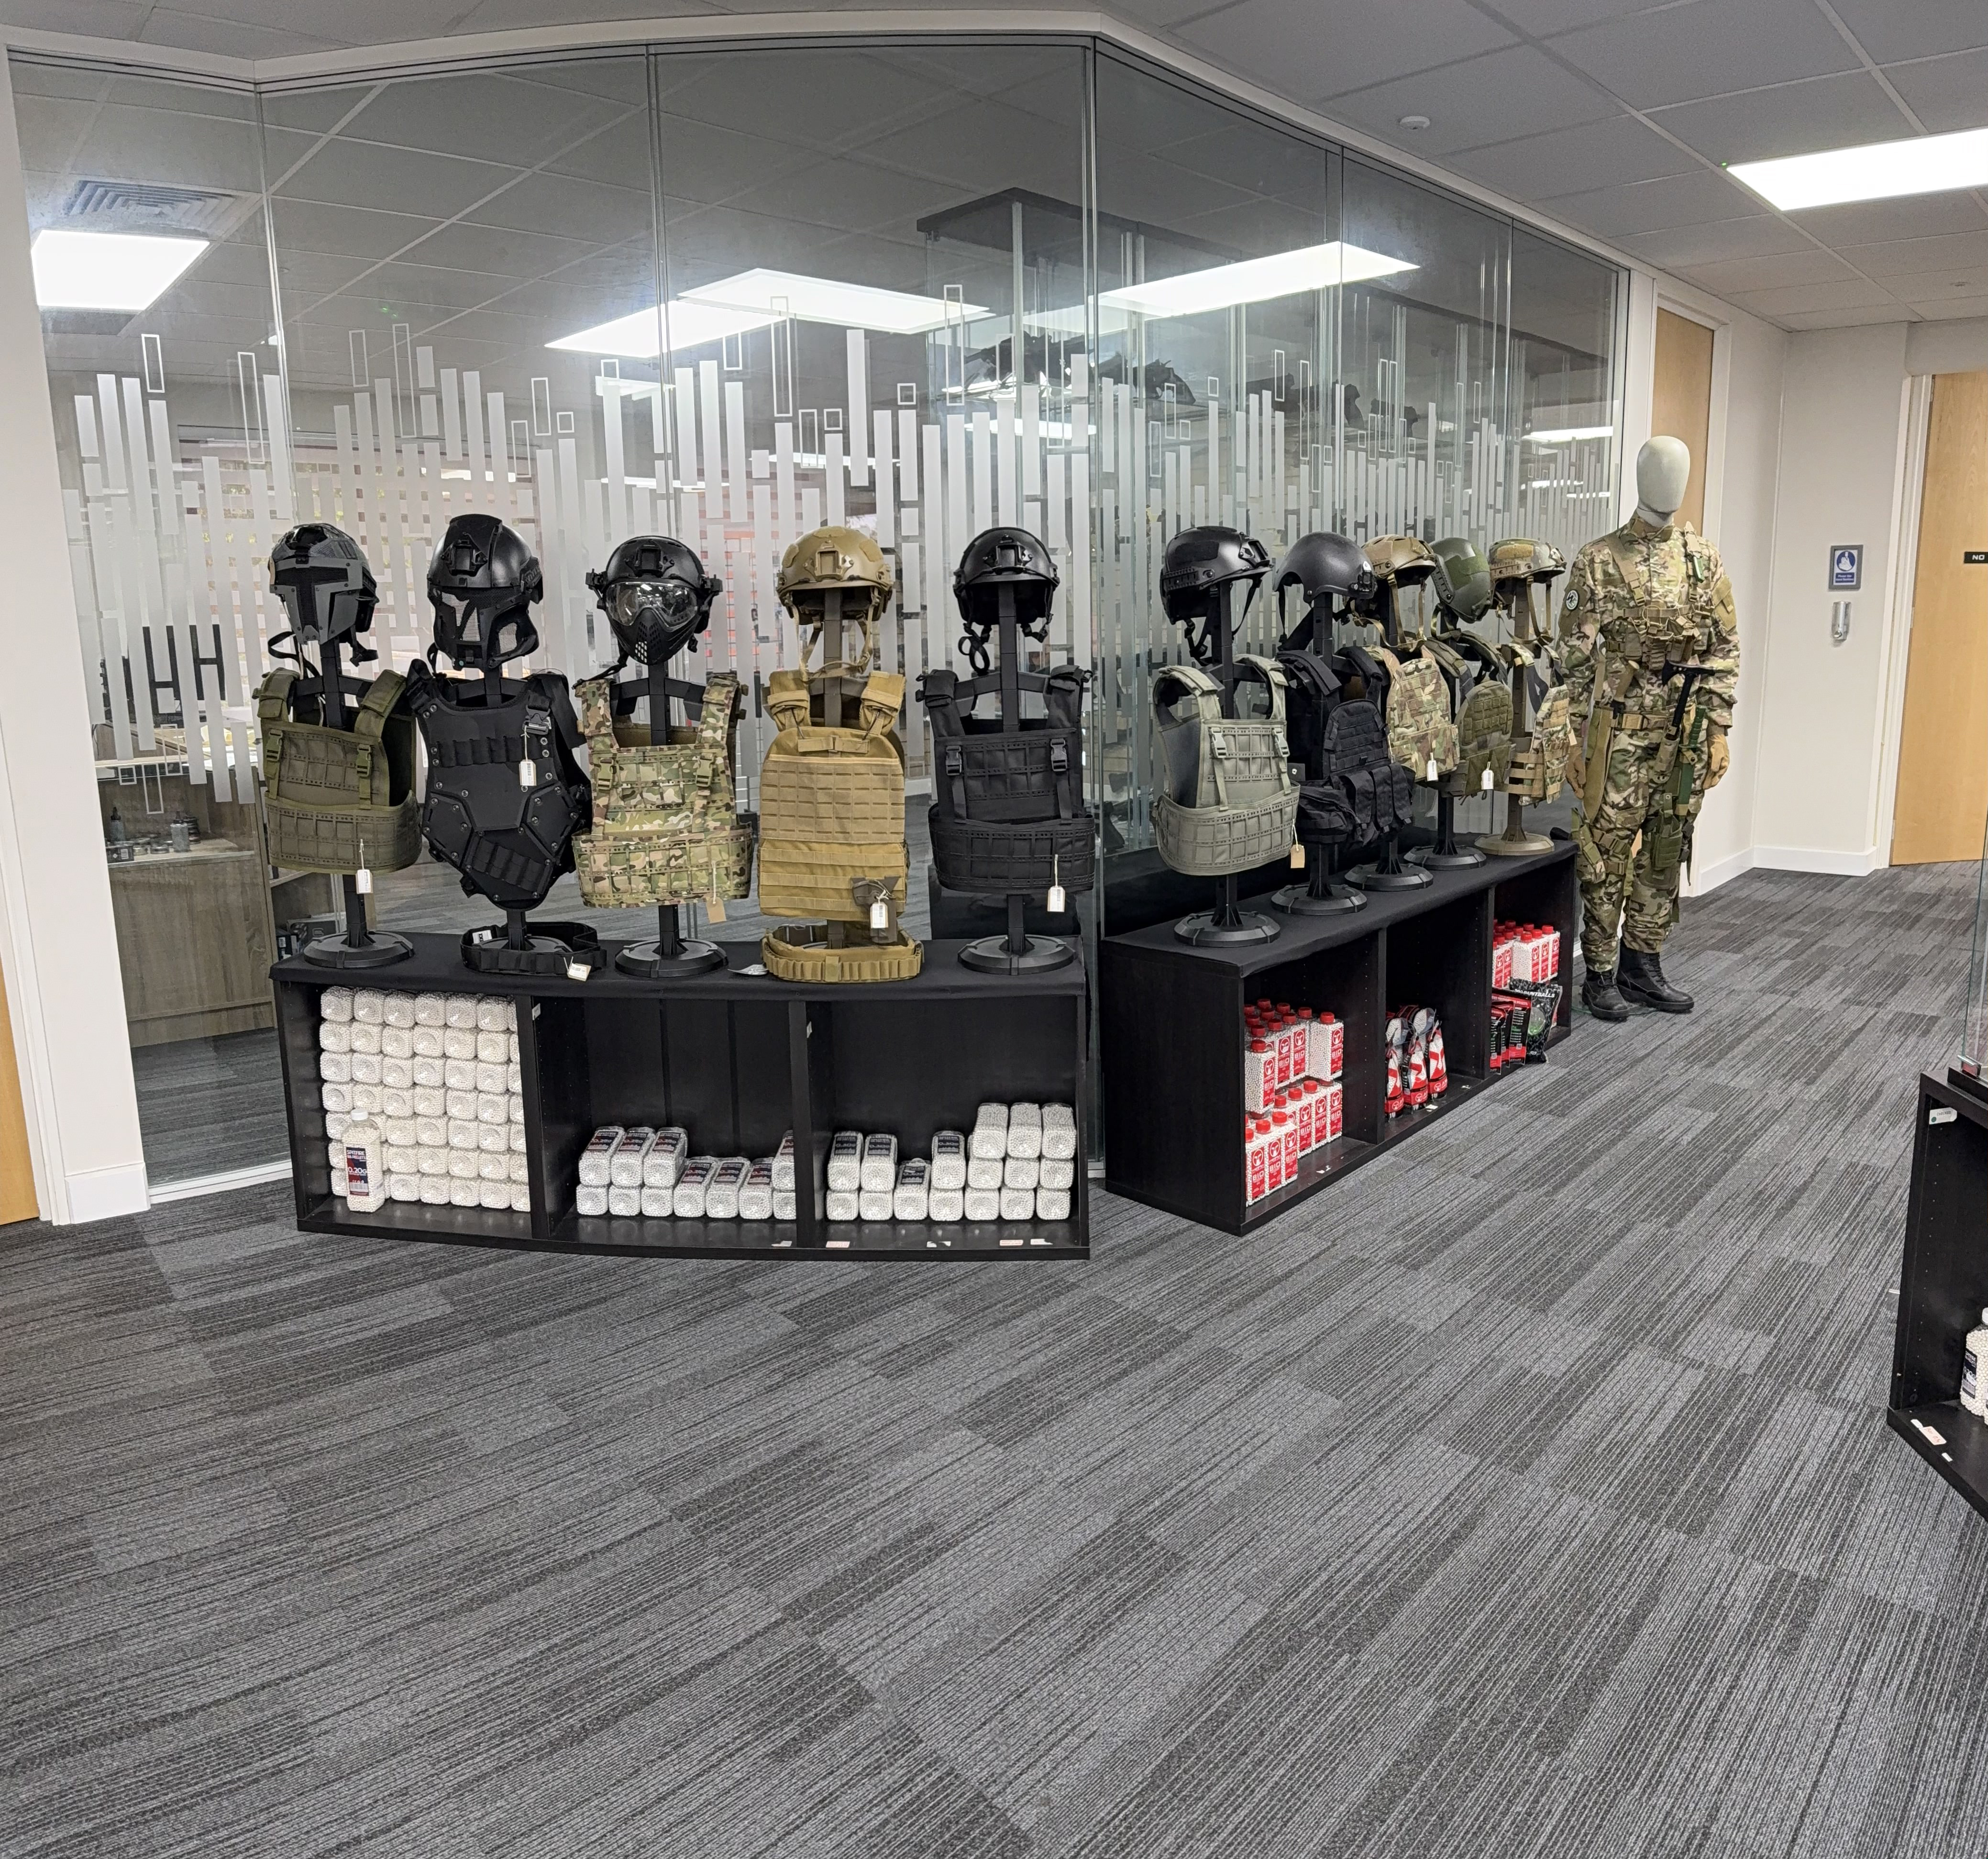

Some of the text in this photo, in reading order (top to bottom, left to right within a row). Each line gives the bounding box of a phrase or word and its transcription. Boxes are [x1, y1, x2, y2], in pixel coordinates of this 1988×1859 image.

[1294, 1050, 1305, 1059] BIO
[1332, 1049, 1342, 1057] BIO
[1279, 1058, 1290, 1066] BIO
[1264, 1080, 1274, 1088] BIO
[1331, 1110, 1341, 1119] BIO
[1316, 1117, 1326, 1126] BIO
[1300, 1125, 1311, 1134] BIO
[1286, 1151, 1296, 1162] BIO
[1270, 1161, 1281, 1172] BIO
[1252, 1170, 1264, 1181] BIO
